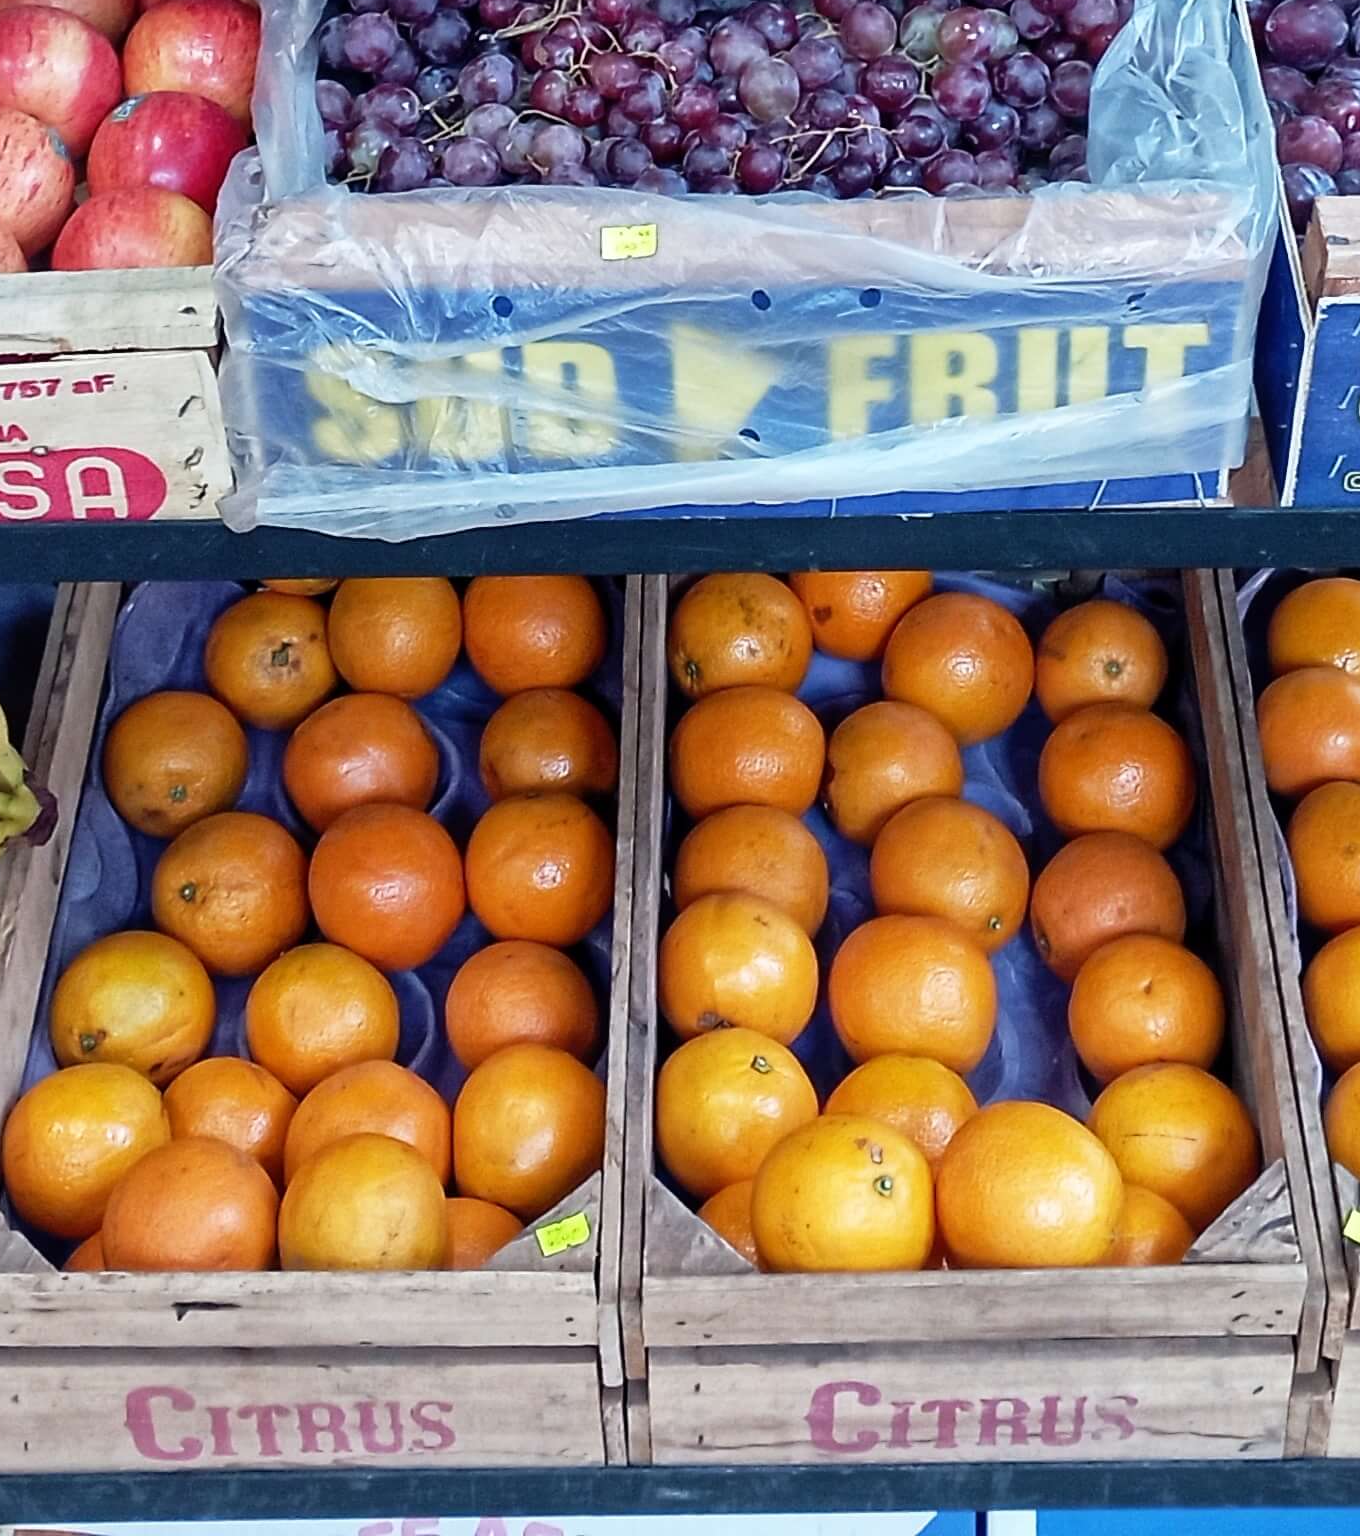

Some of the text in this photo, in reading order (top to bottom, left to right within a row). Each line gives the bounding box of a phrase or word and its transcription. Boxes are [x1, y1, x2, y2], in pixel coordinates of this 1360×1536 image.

[828, 322, 1210, 439] FRUT
[122, 1384, 456, 1464] CITRUS
[804, 1380, 1144, 1455] CITRUS
